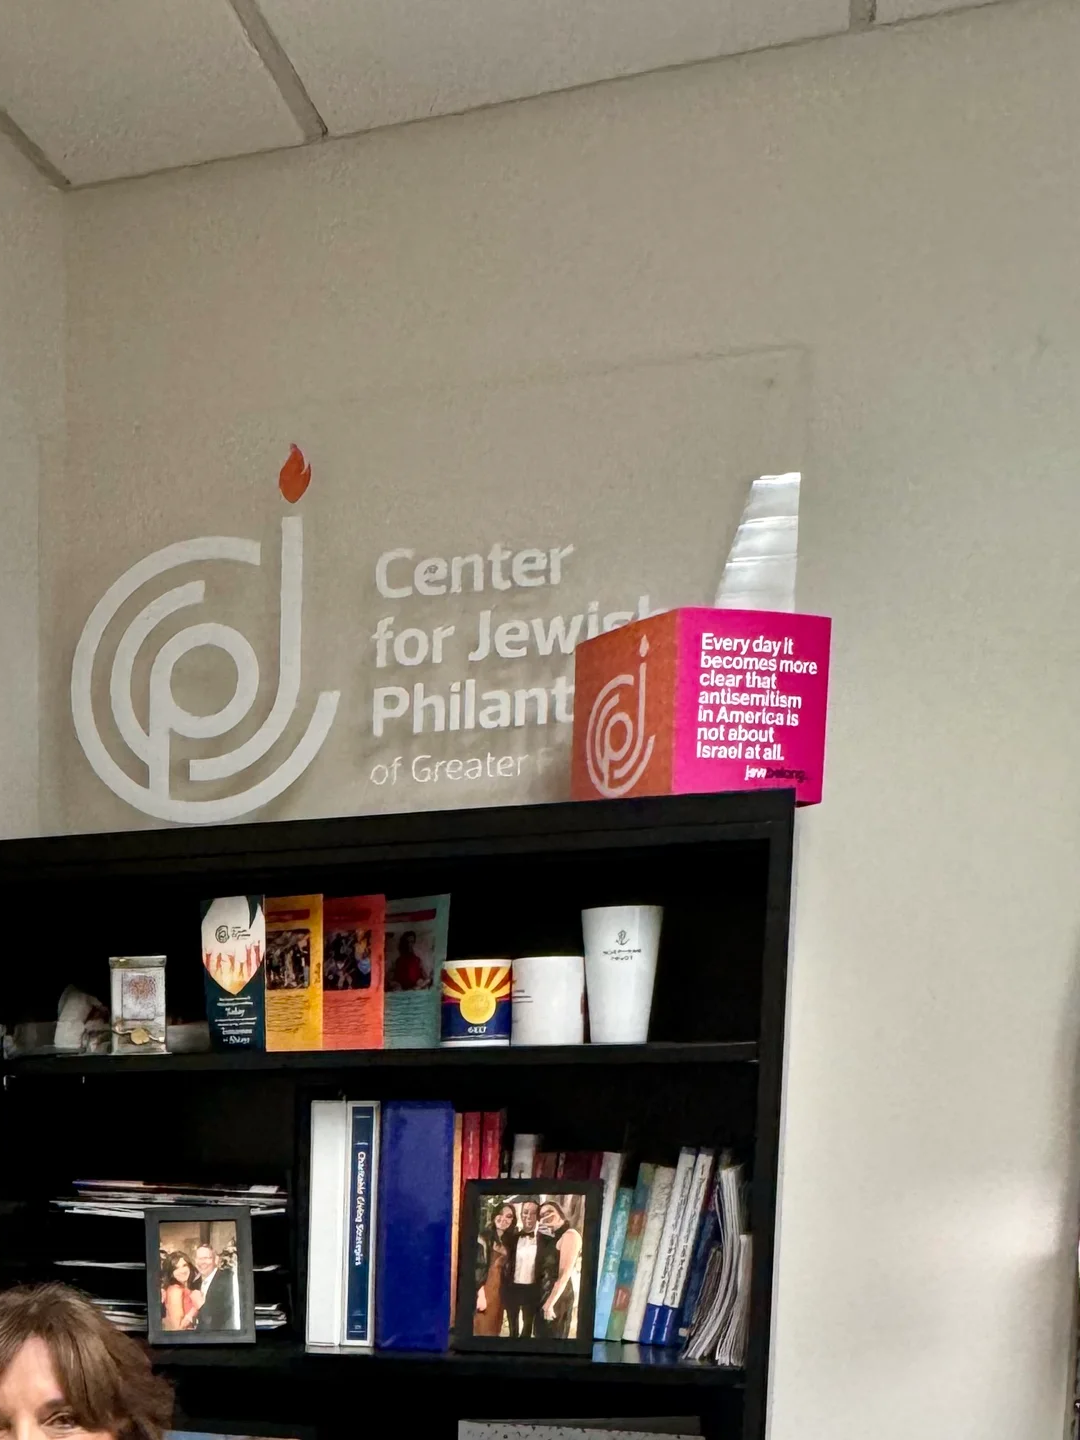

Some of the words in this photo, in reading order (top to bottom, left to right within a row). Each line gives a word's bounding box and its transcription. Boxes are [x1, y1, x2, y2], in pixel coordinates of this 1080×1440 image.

[375, 544, 575, 599] Center
[371, 616, 456, 668] for
[701, 633, 750, 655] Every
[752, 635, 781, 657] day
[783, 637, 794, 655] it
[700, 651, 777, 671] becomes
[779, 659, 818, 675] more
[699, 670, 744, 687] clear
[746, 671, 778, 689] that
[698, 688, 802, 709] antisemitism
[697, 705, 714, 723] in
[716, 706, 785, 726] America
[786, 709, 799, 727] is
[697, 724, 725, 741] not
[728, 725, 775, 742] about
[696, 741, 743, 759] Israel
[745, 744, 761, 760] at
[762, 743, 785, 761] all.
[370, 756, 402, 785] of
[411, 752, 530, 783] Greater
